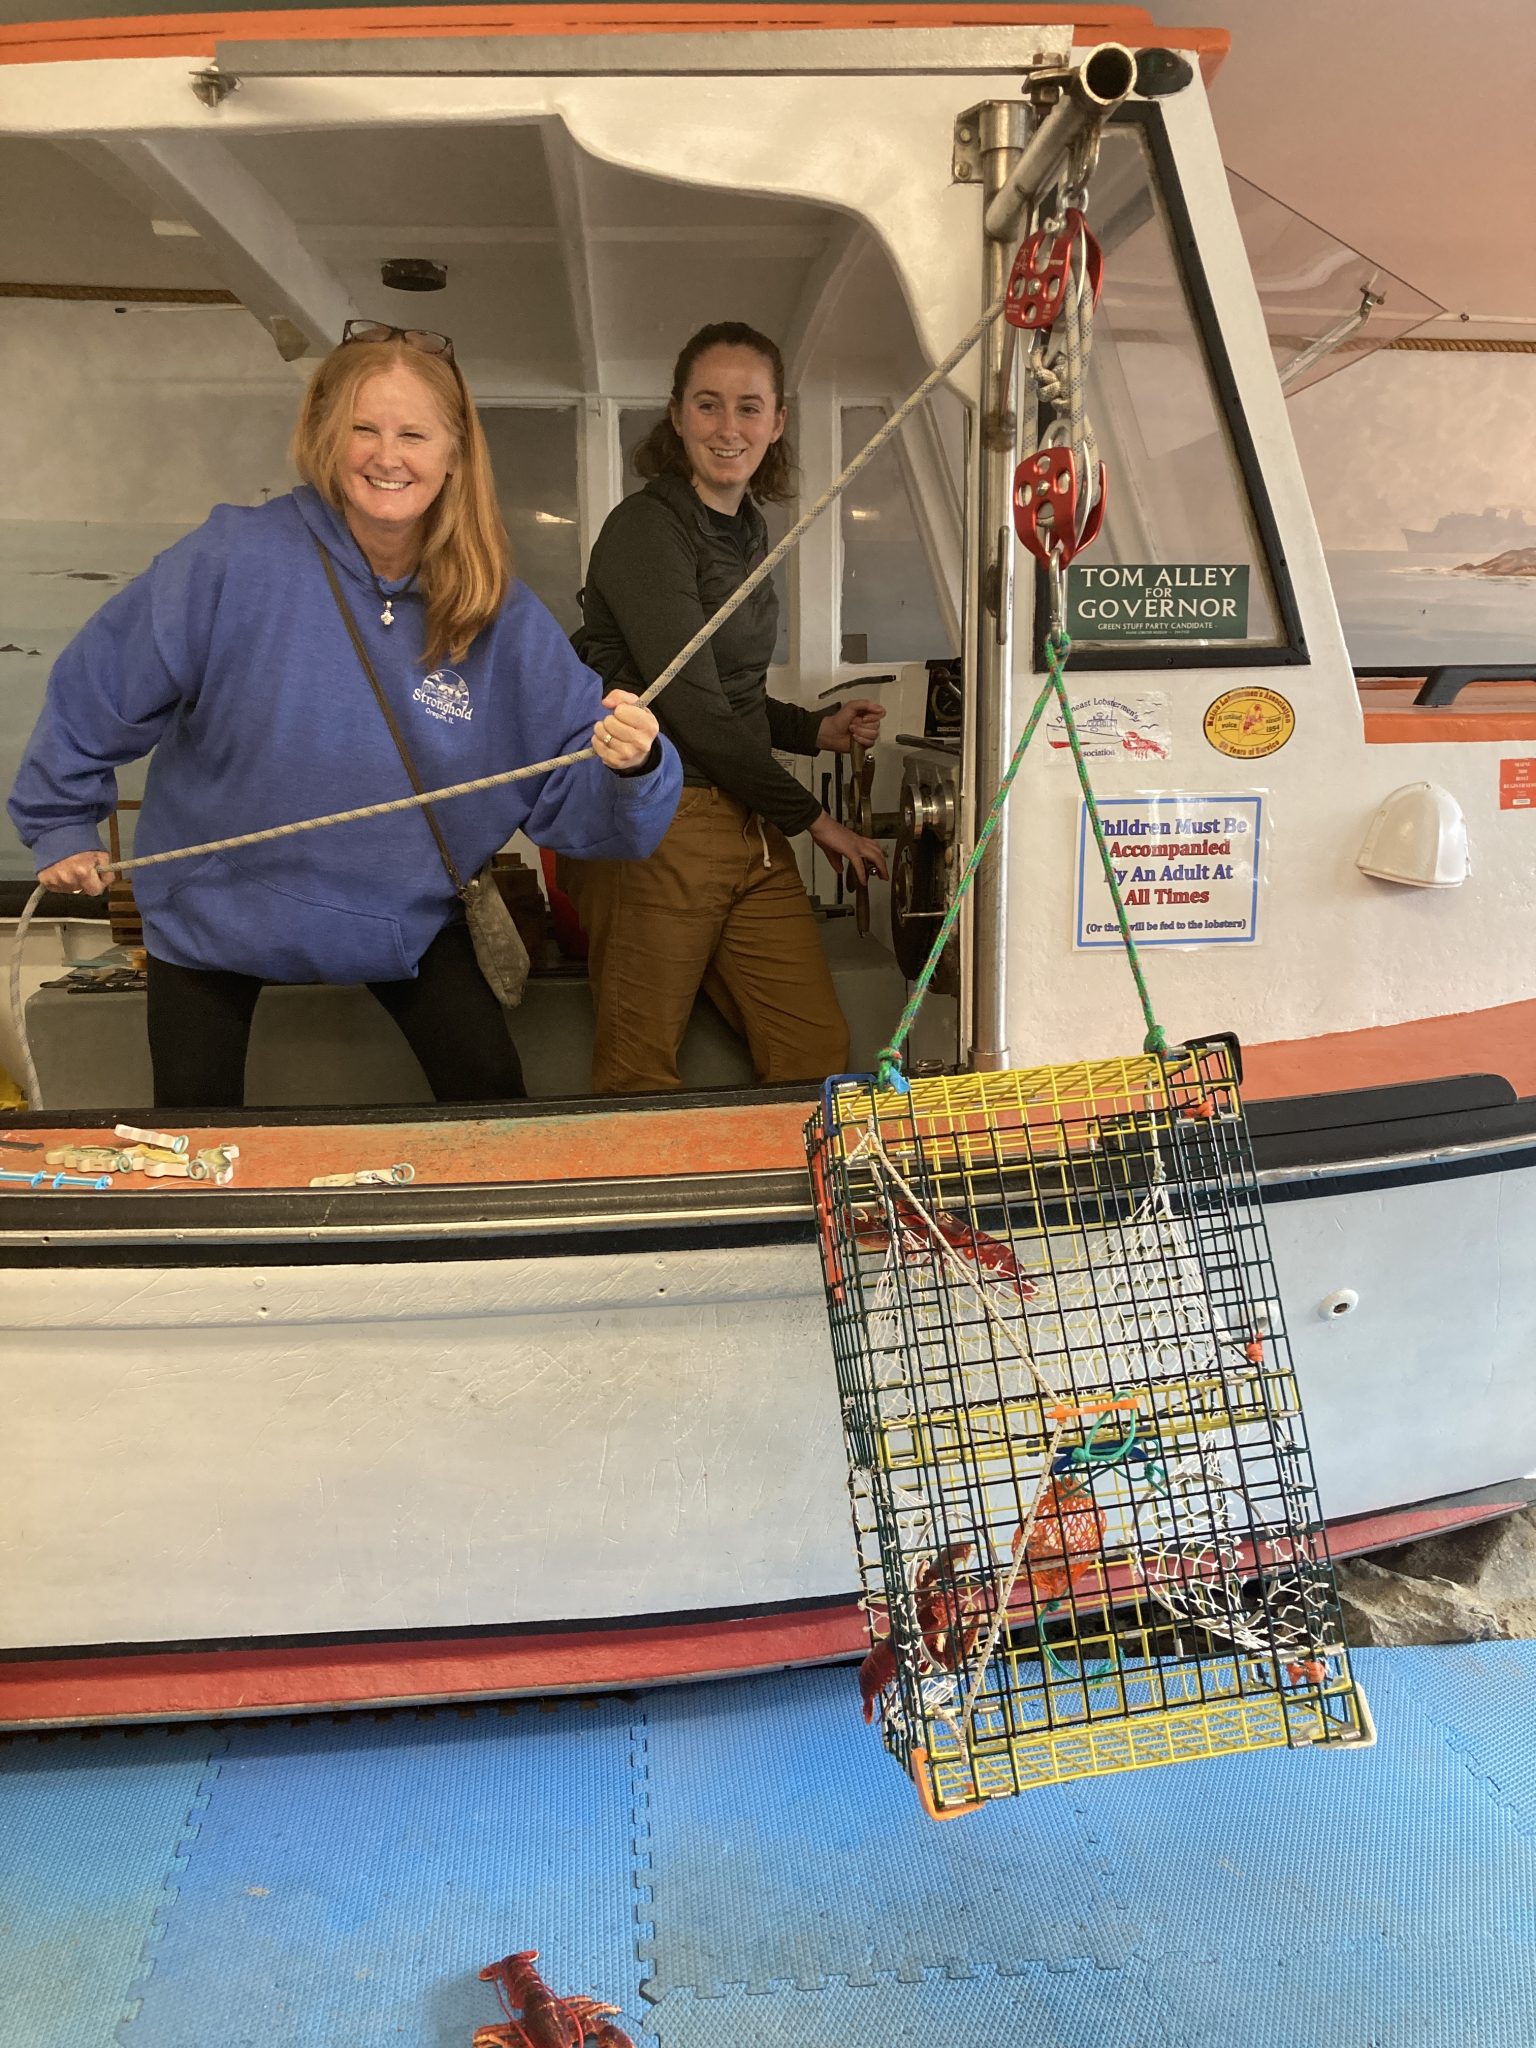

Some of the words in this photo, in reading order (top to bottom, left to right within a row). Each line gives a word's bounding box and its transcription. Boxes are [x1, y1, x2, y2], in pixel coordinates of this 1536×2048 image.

[1080, 568, 1144, 587] TOM
[1154, 567, 1237, 587] ALLEY
[1145, 587, 1172, 598] FOR
[1078, 598, 1237, 619] GOVERNOR
[1122, 622, 1144, 630] STUFF
[1170, 621, 1213, 629] CANDIDATE
[412, 688, 473, 720] Stronghold
[1056, 700, 1091, 724] Dneast
[1093, 697, 1139, 720] Lobstermen's
[1207, 705, 1221, 727] Maine
[1264, 691, 1291, 724] Association
[1221, 721, 1237, 729] voice
[1266, 724, 1280, 733] 1954
[1082, 748, 1115, 757] sociation
[1100, 818, 1171, 836] hildren
[1175, 818, 1220, 834] Must
[1223, 817, 1248, 834] Be
[1110, 839, 1231, 860] Accompanied
[1130, 866, 1156, 882] An
[1159, 864, 1210, 881] Adult
[1212, 864, 1233, 880] At
[1124, 889, 1150, 905] All
[1154, 888, 1210, 904] Times
[1086, 923, 1103, 934] (Or
[1104, 922, 1122, 934] the
[1146, 921, 1158, 931] be
[1160, 921, 1175, 930] fed
[1176, 921, 1186, 930] to
[1188, 920, 1203, 929] the
[1204, 918, 1246, 930] lobsters)
